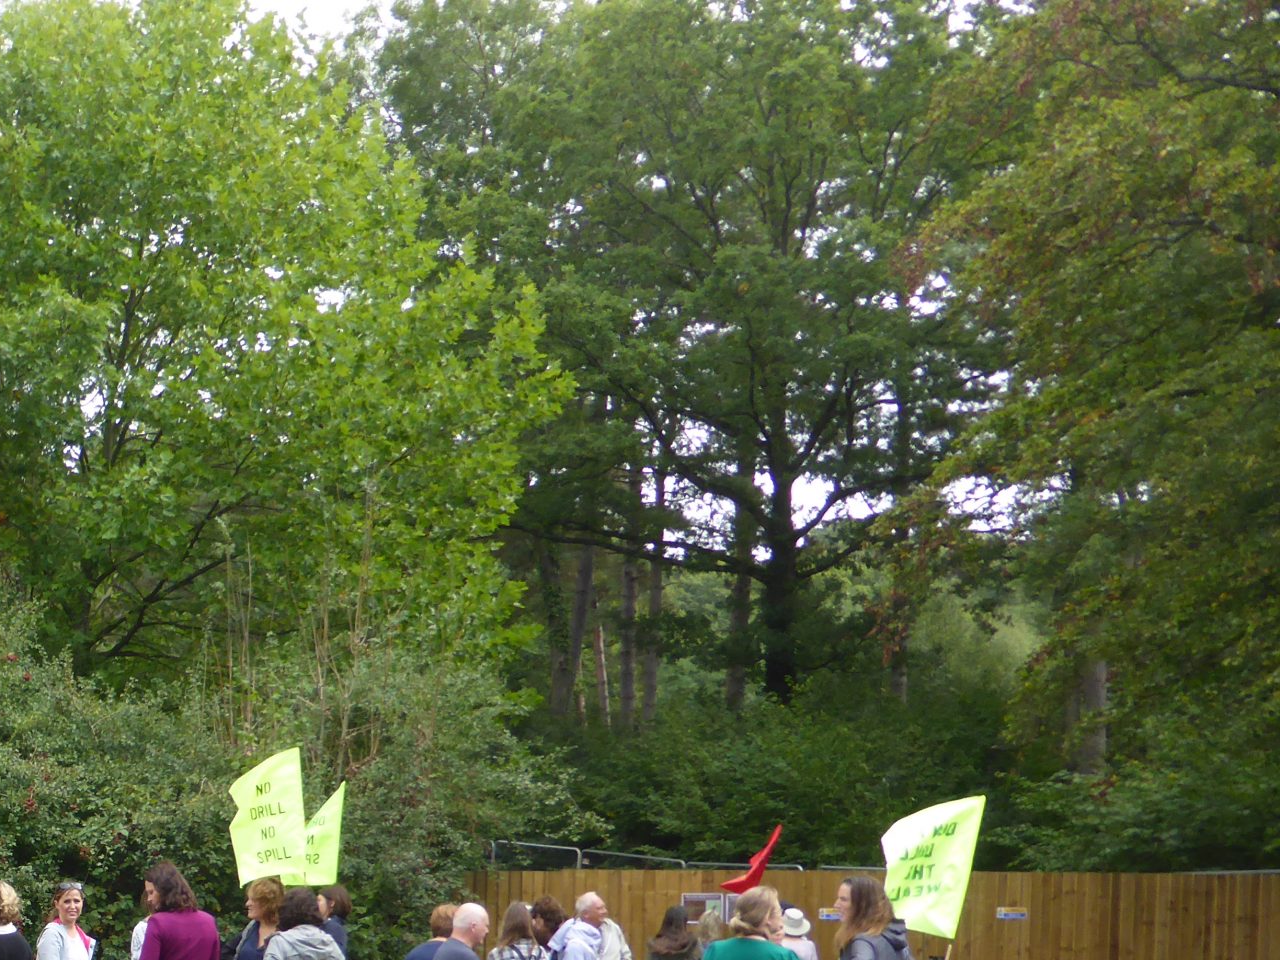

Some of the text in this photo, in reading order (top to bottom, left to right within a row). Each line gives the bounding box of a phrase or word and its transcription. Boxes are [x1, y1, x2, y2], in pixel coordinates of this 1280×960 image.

[256, 782, 271, 797] NO
[250, 802, 286, 821] DRILL
[261, 826, 276, 840] NO
[257, 847, 292, 864] SPILL
